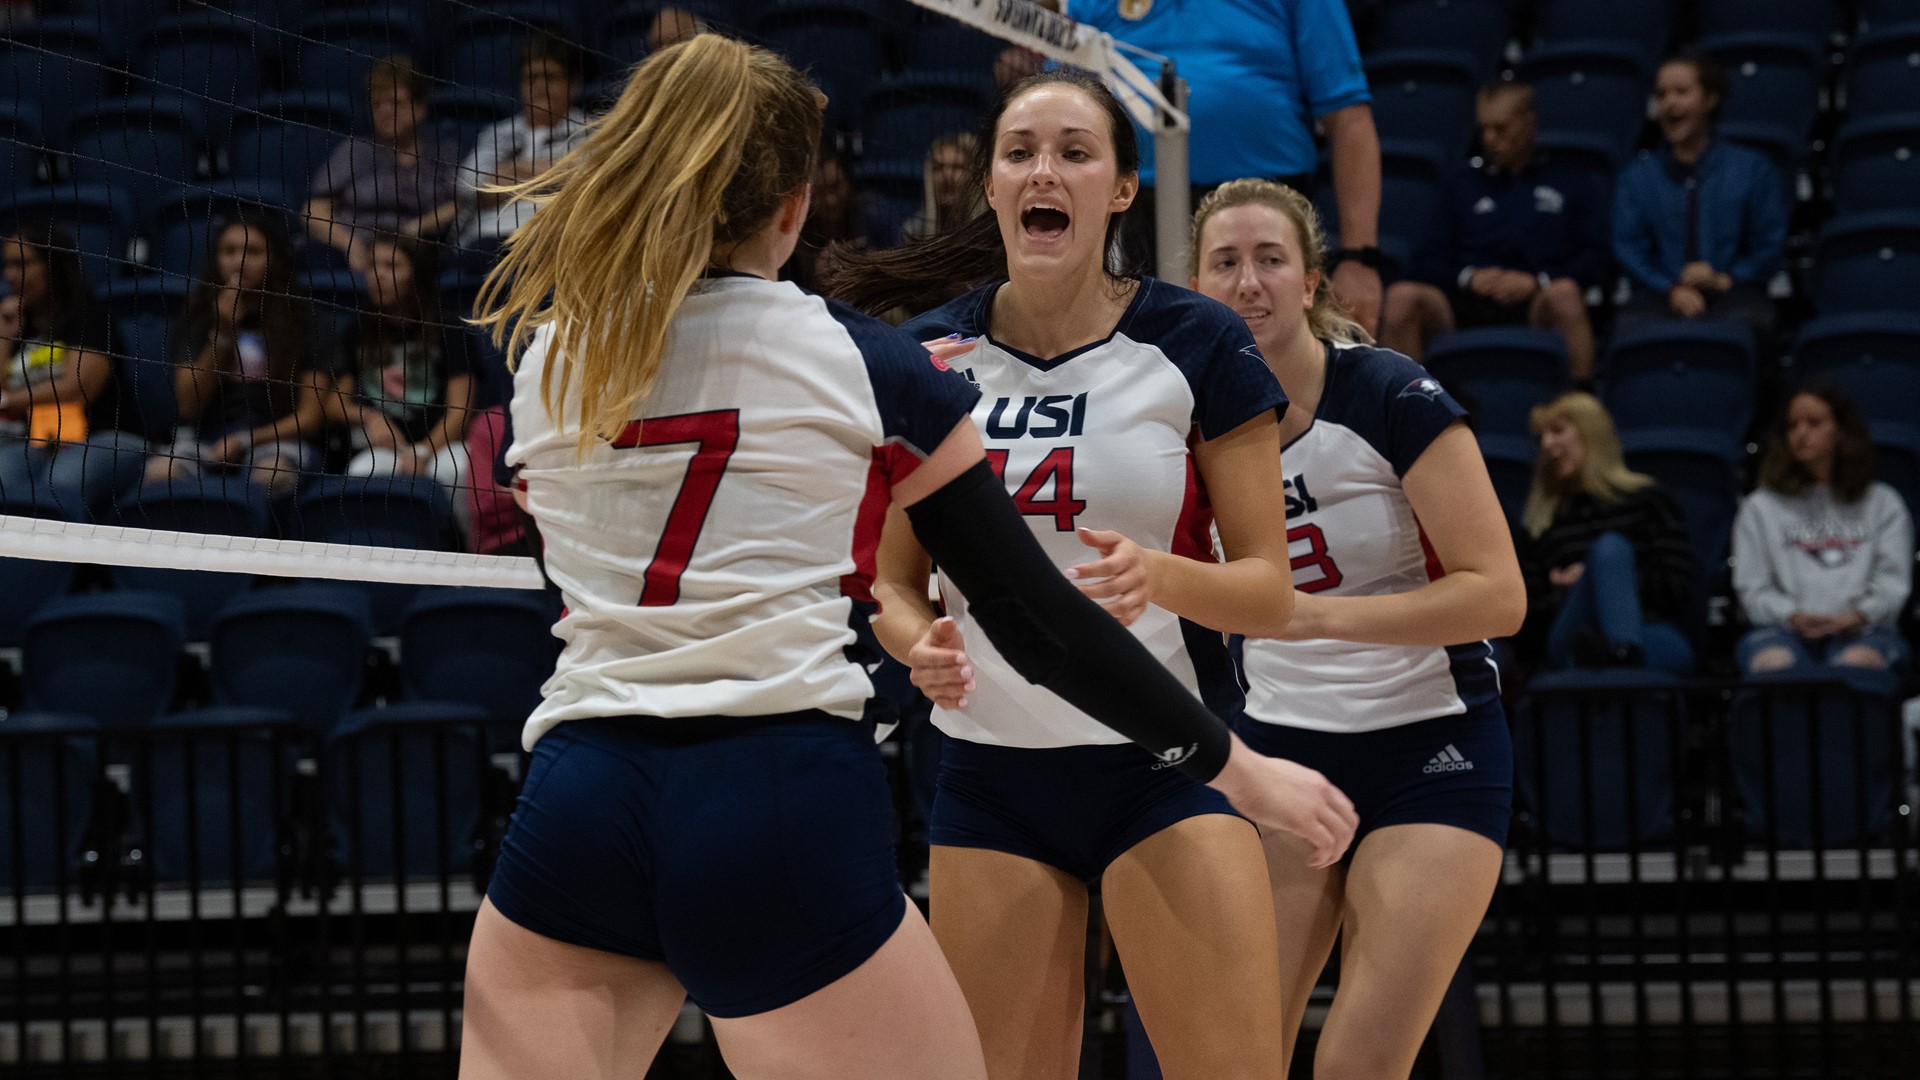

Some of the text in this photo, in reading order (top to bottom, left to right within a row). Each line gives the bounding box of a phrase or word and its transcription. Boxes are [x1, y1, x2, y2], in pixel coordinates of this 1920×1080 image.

[985, 391, 1089, 440] USI
[597, 408, 740, 607] 7
[1283, 473, 1318, 520] SI
[1422, 760, 1474, 774] adidas
